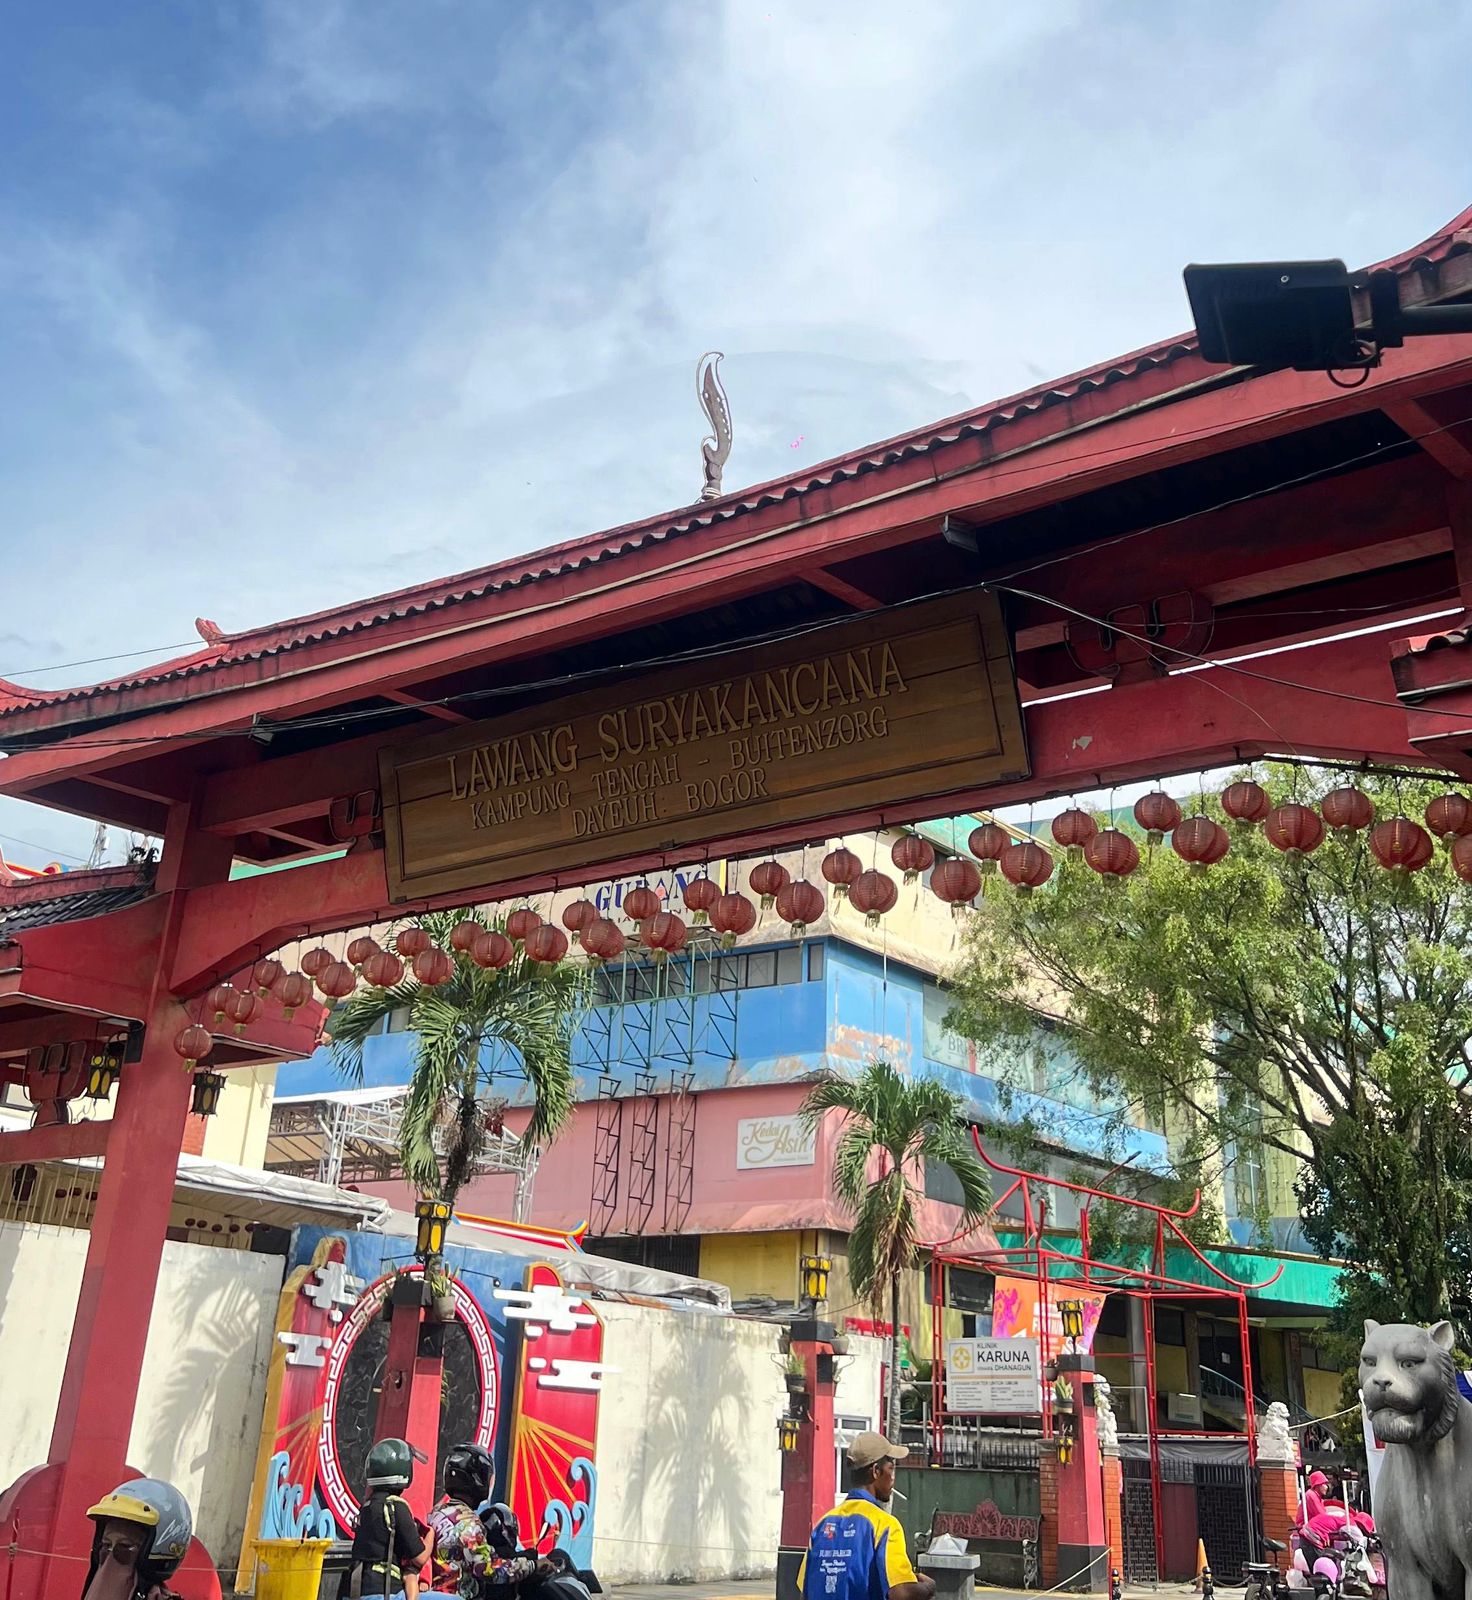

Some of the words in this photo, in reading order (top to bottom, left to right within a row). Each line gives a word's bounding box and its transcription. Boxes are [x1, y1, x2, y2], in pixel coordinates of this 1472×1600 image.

[447, 724, 579, 801] LAWANG
[599, 641, 909, 763] SURYAKANCANA
[471, 780, 572, 830] KAMPUNG
[592, 753, 681, 801] TENGAH
[728, 705, 889, 770] BUITENZORG
[572, 792, 660, 837] DAYEUH
[685, 768, 769, 812] BOGOR
[977, 1350, 1030, 1363] KARUNA
